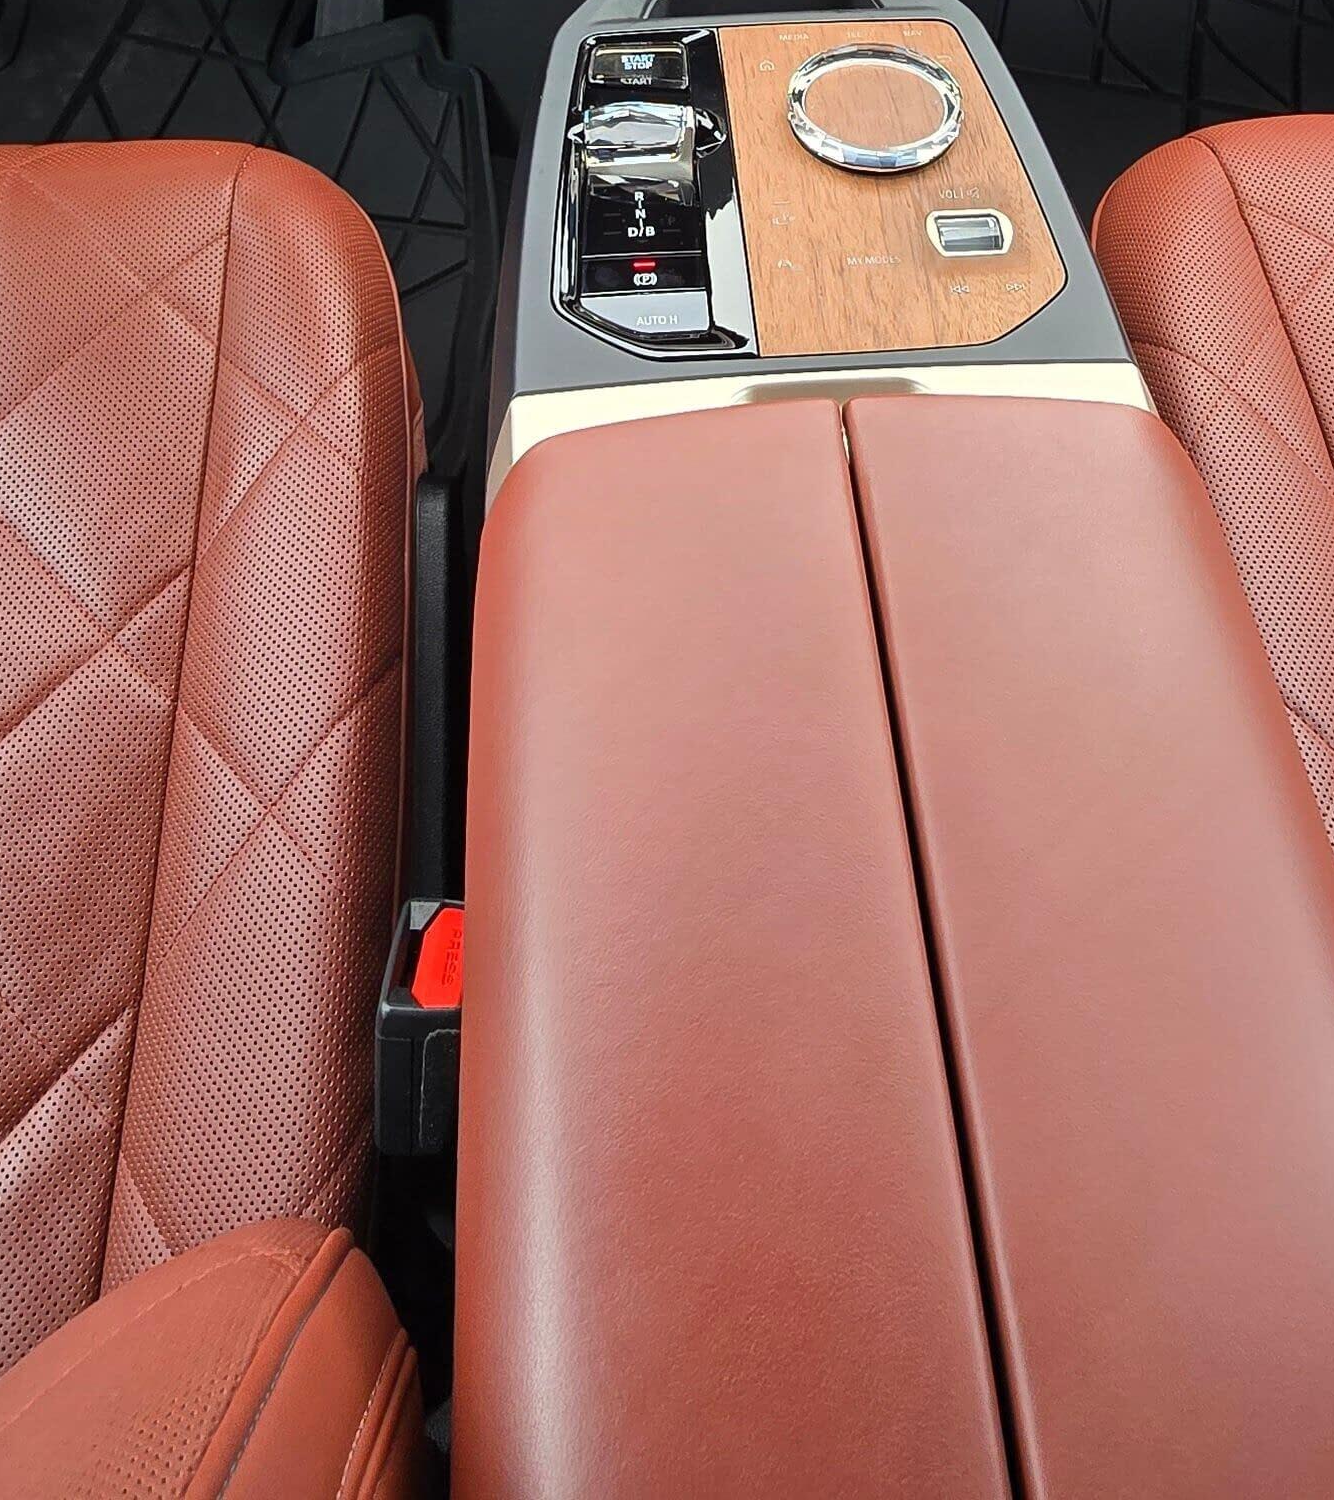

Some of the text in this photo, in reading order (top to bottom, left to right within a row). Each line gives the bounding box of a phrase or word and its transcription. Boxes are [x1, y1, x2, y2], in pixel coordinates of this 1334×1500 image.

[778, 33, 810, 42] MEDIA
[903, 29, 923, 37] NAV
[621, 54, 655, 63] START
[624, 62, 653, 70] STOP
[634, 191, 645, 201] R
[635, 209, 646, 219] N
[636, 315, 678, 326] AUTO H
